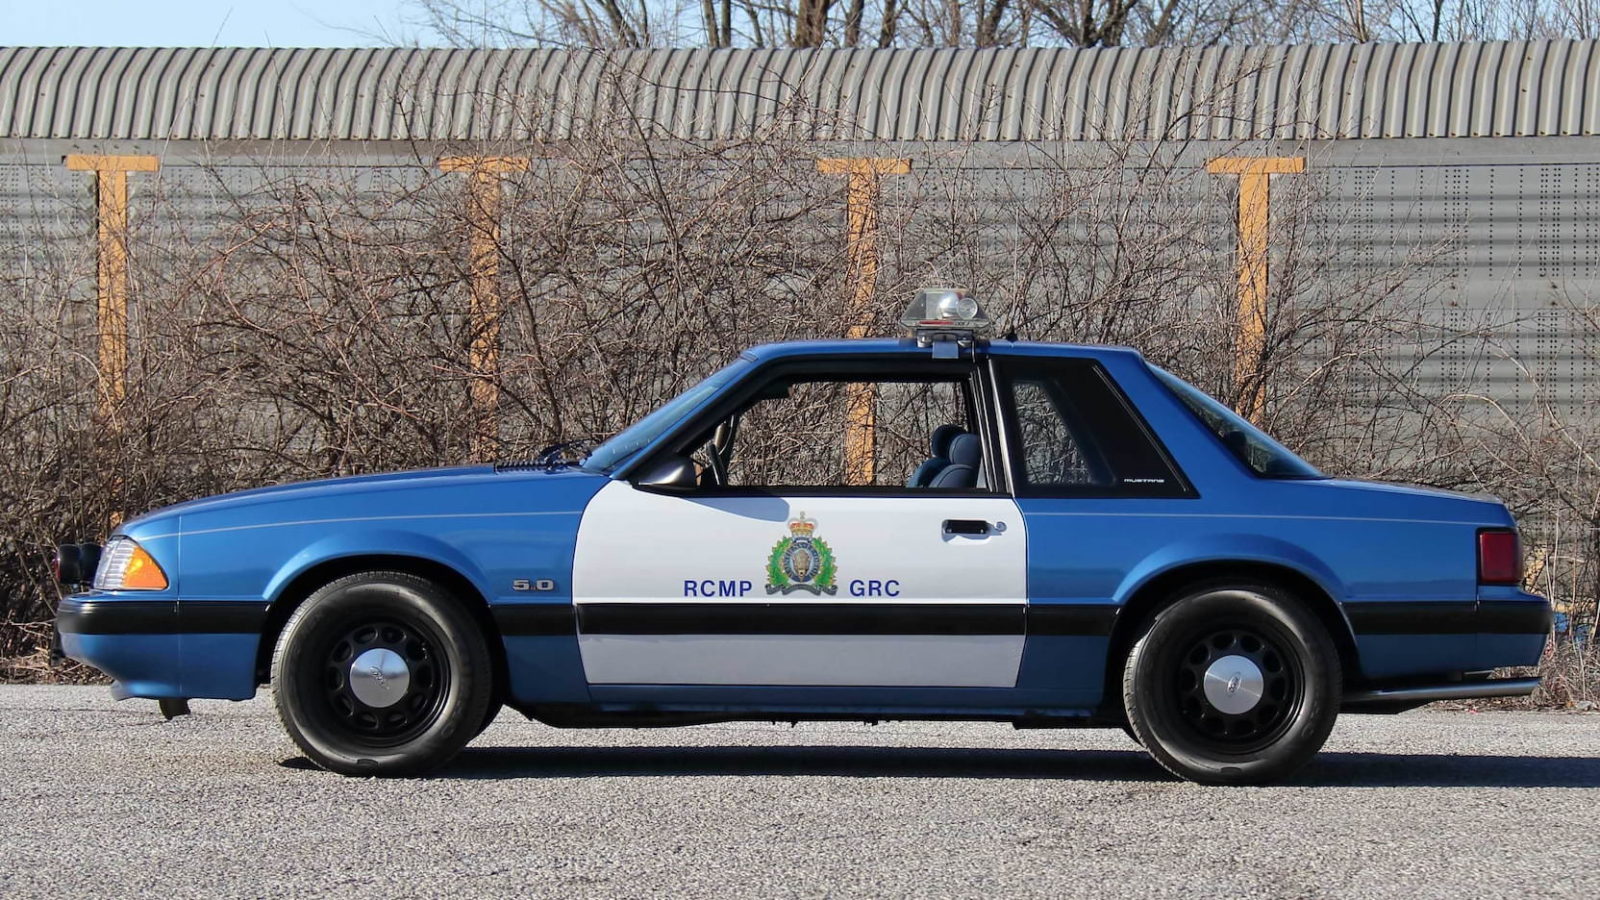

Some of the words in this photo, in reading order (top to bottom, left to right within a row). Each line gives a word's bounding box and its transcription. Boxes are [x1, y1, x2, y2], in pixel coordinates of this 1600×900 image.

[512, 579, 554, 591] 5.0
[683, 580, 752, 597] RCMP
[849, 579, 900, 597] GRC
